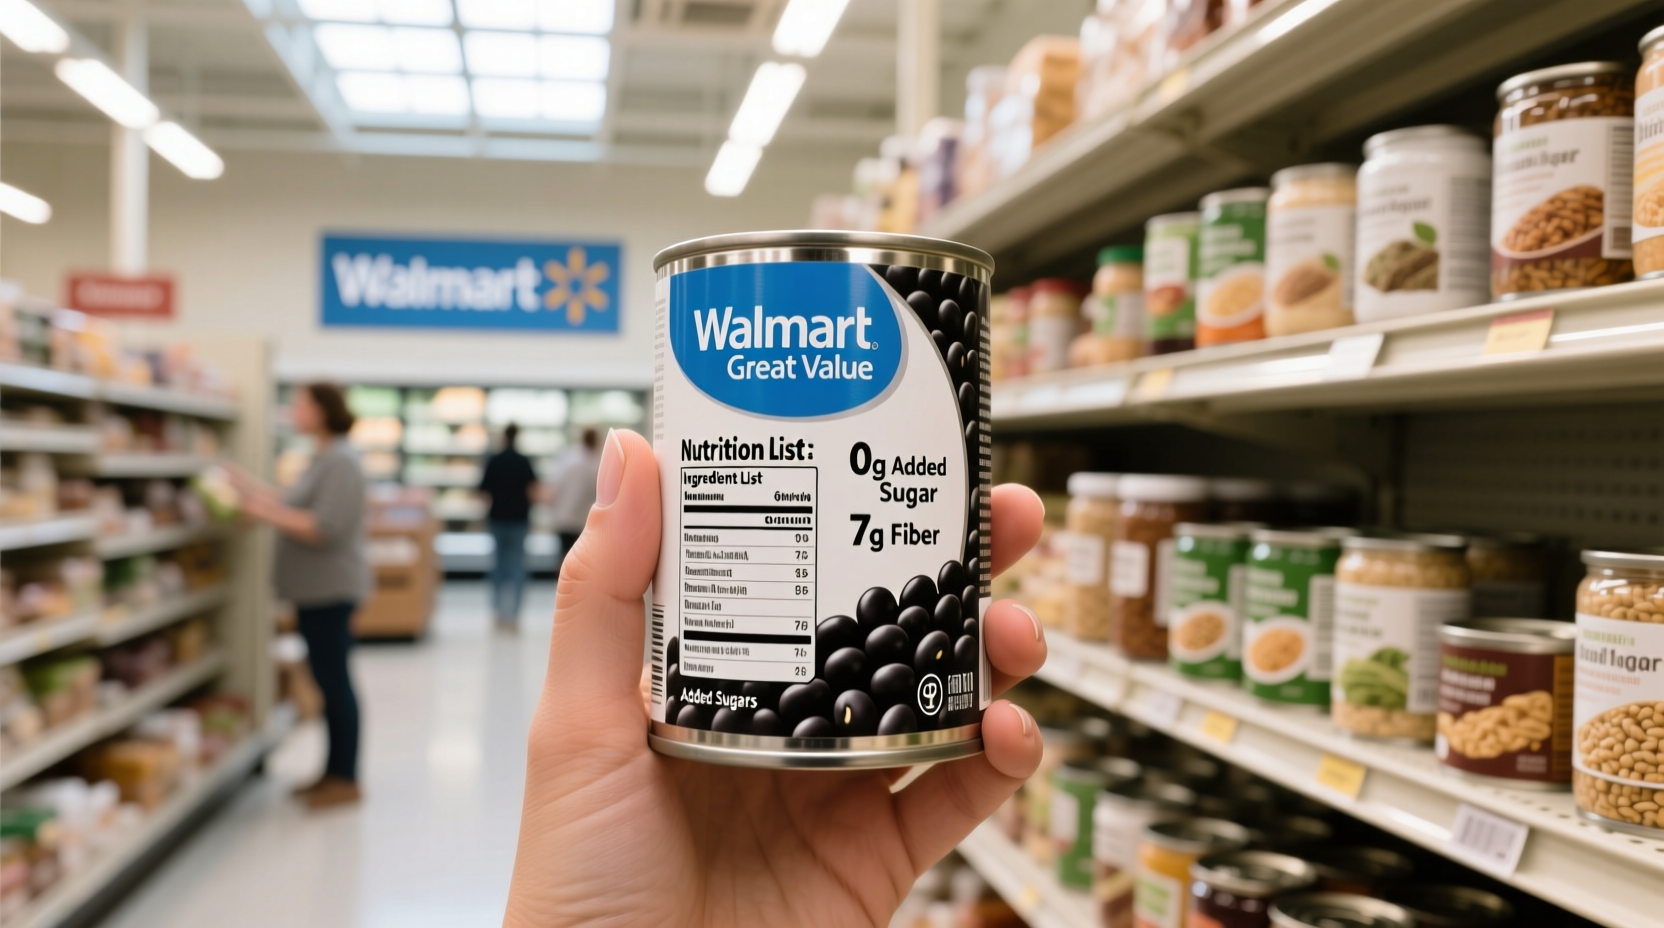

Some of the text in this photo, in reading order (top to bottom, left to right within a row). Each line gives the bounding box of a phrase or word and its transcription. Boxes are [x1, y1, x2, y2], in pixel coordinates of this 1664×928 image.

[332, 253, 541, 311] Walmart
[693, 306, 872, 351] Walmart
[727, 354, 873, 379] Great Value
[681, 436, 814, 461] Nutrition List:
[850, 442, 947, 481] 0g Added
[683, 470, 763, 488] Ingredient List
[880, 482, 938, 508] Sugar
[850, 513, 940, 552] 7g Fiber
[680, 687, 758, 711] Added Sugars
